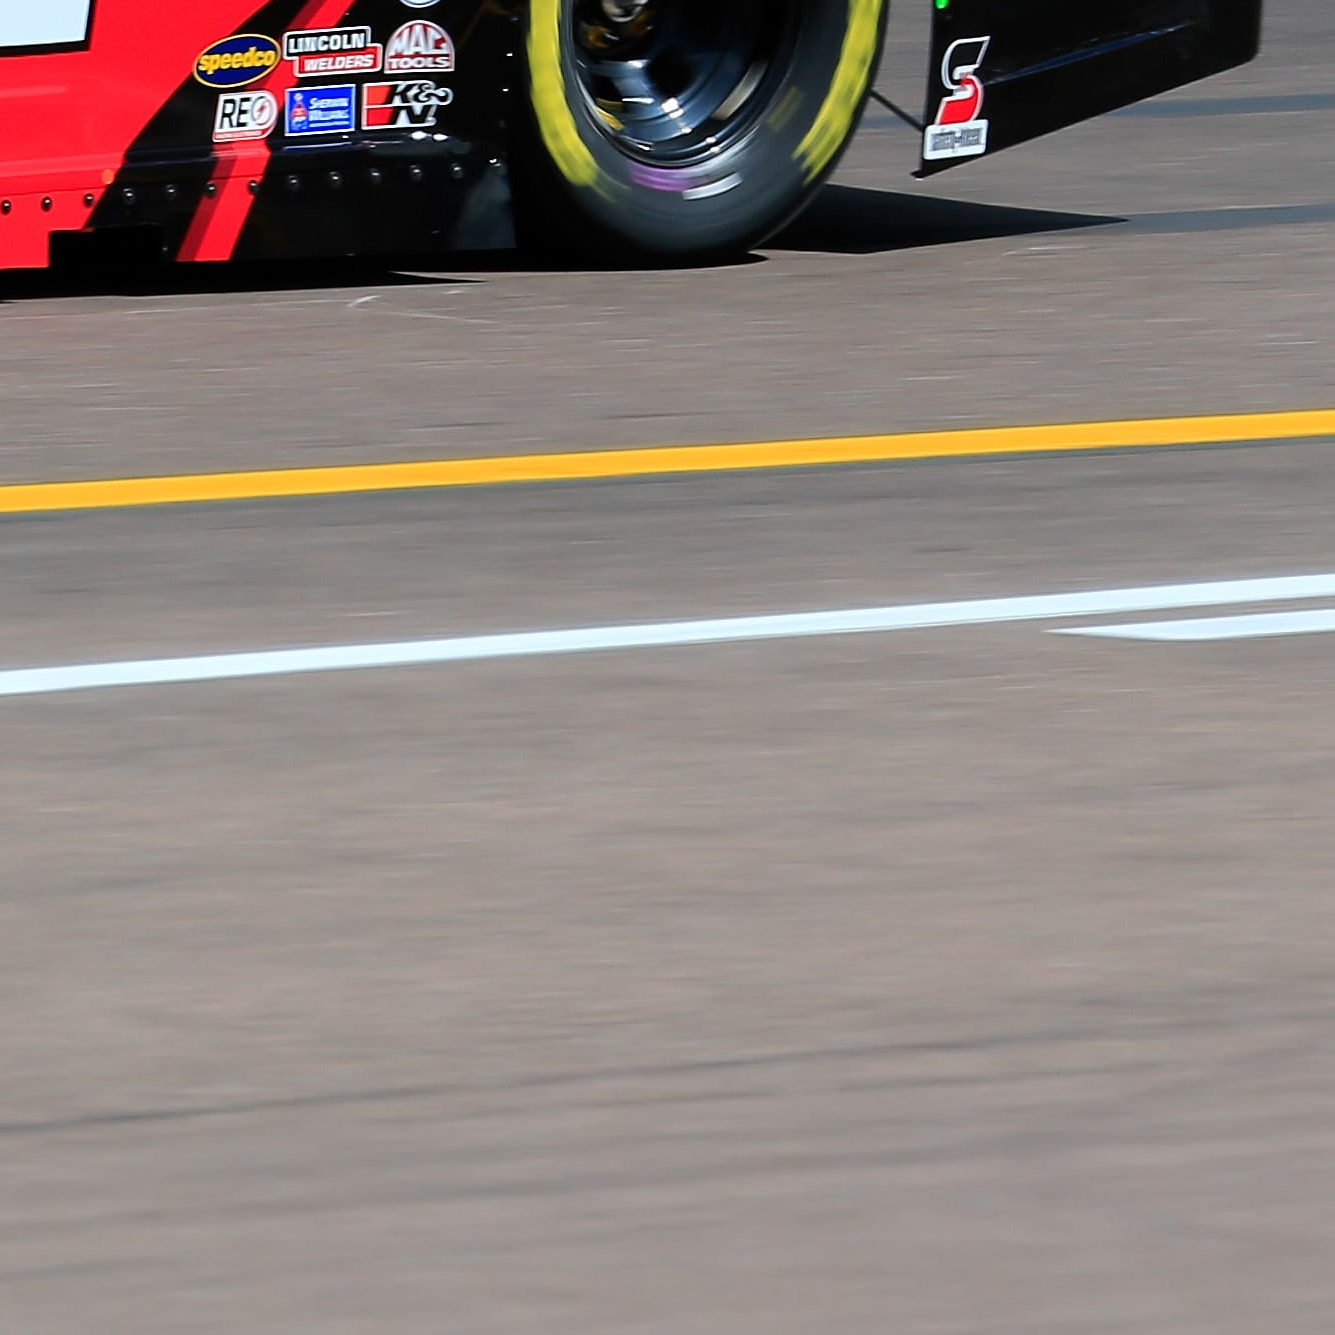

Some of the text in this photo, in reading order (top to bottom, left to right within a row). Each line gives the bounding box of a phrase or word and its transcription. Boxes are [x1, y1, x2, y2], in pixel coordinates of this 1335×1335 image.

[287, 32, 366, 54] LINCOLN
[389, 23, 447, 55] MAC
[196, 47, 277, 76] speedco
[303, 53, 375, 72] WELDERS
[388, 55, 450, 69] TOOLS
